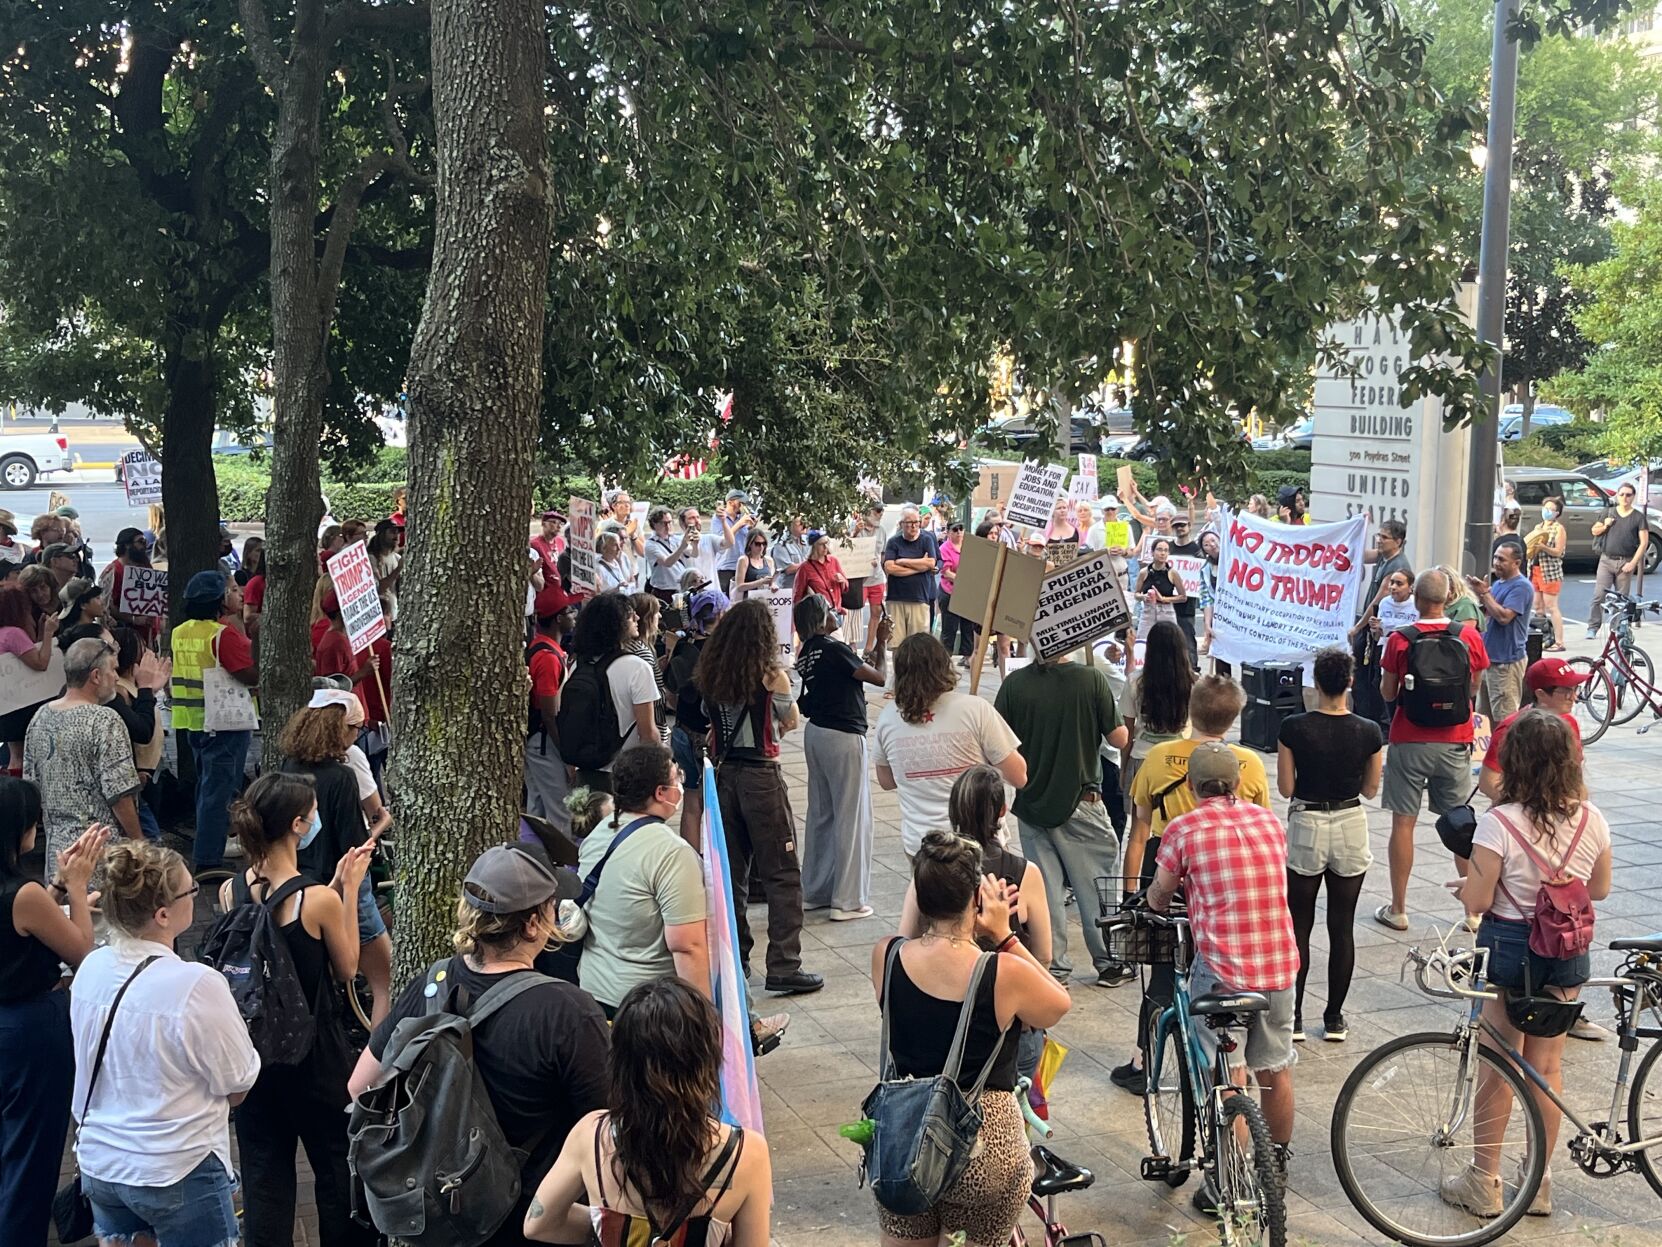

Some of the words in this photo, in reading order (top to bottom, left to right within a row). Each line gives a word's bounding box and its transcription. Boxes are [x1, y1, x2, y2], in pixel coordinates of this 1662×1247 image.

[1354, 325, 1399, 345] HAL
[1353, 355, 1402, 375] OGG
[1351, 386, 1402, 406] FEDERA
[1350, 415, 1412, 436] BUILDING
[1349, 451, 1361, 461] 500
[1364, 450, 1389, 463] Poydras
[1391, 452, 1411, 463] Street
[1022, 473, 1041, 485] JOBS
[1042, 479, 1057, 490] AND
[1024, 464, 1048, 477] MONEY
[1049, 471, 1061, 480] FOR
[1075, 481, 1090, 494] SAY
[1348, 474, 1410, 498] UNITED
[1014, 493, 1026, 503] NOT
[1027, 497, 1053, 508] MILITARY
[1230, 519, 1264, 553] NO
[329, 543, 365, 576] FIGHT
[1177, 560, 1201, 571] TRUM
[128, 567, 152, 581] NO
[155, 570, 168, 585] WA
[334, 557, 372, 596] TRUMP'S
[1048, 560, 1104, 591] PUEBLO
[1228, 558, 1264, 592] NO
[341, 579, 374, 608] AGENDA
[359, 594, 369, 610] THE
[1053, 581, 1114, 614] AGENDA
[1036, 598, 1118, 638] MULTIMILLONARIA
[1218, 599, 1235, 613] FIGHT
[1235, 609, 1256, 621] TRUMP
[1245, 600, 1270, 613] MILITARY
[1270, 609, 1305, 621] OCCUPATION
[1038, 632, 1060, 648] DE
[1062, 604, 1121, 636] TRUMP!
[1213, 612, 1248, 634] COMMUNITY
[1249, 629, 1277, 643] CONTROL
[1277, 637, 1286, 645] OF
